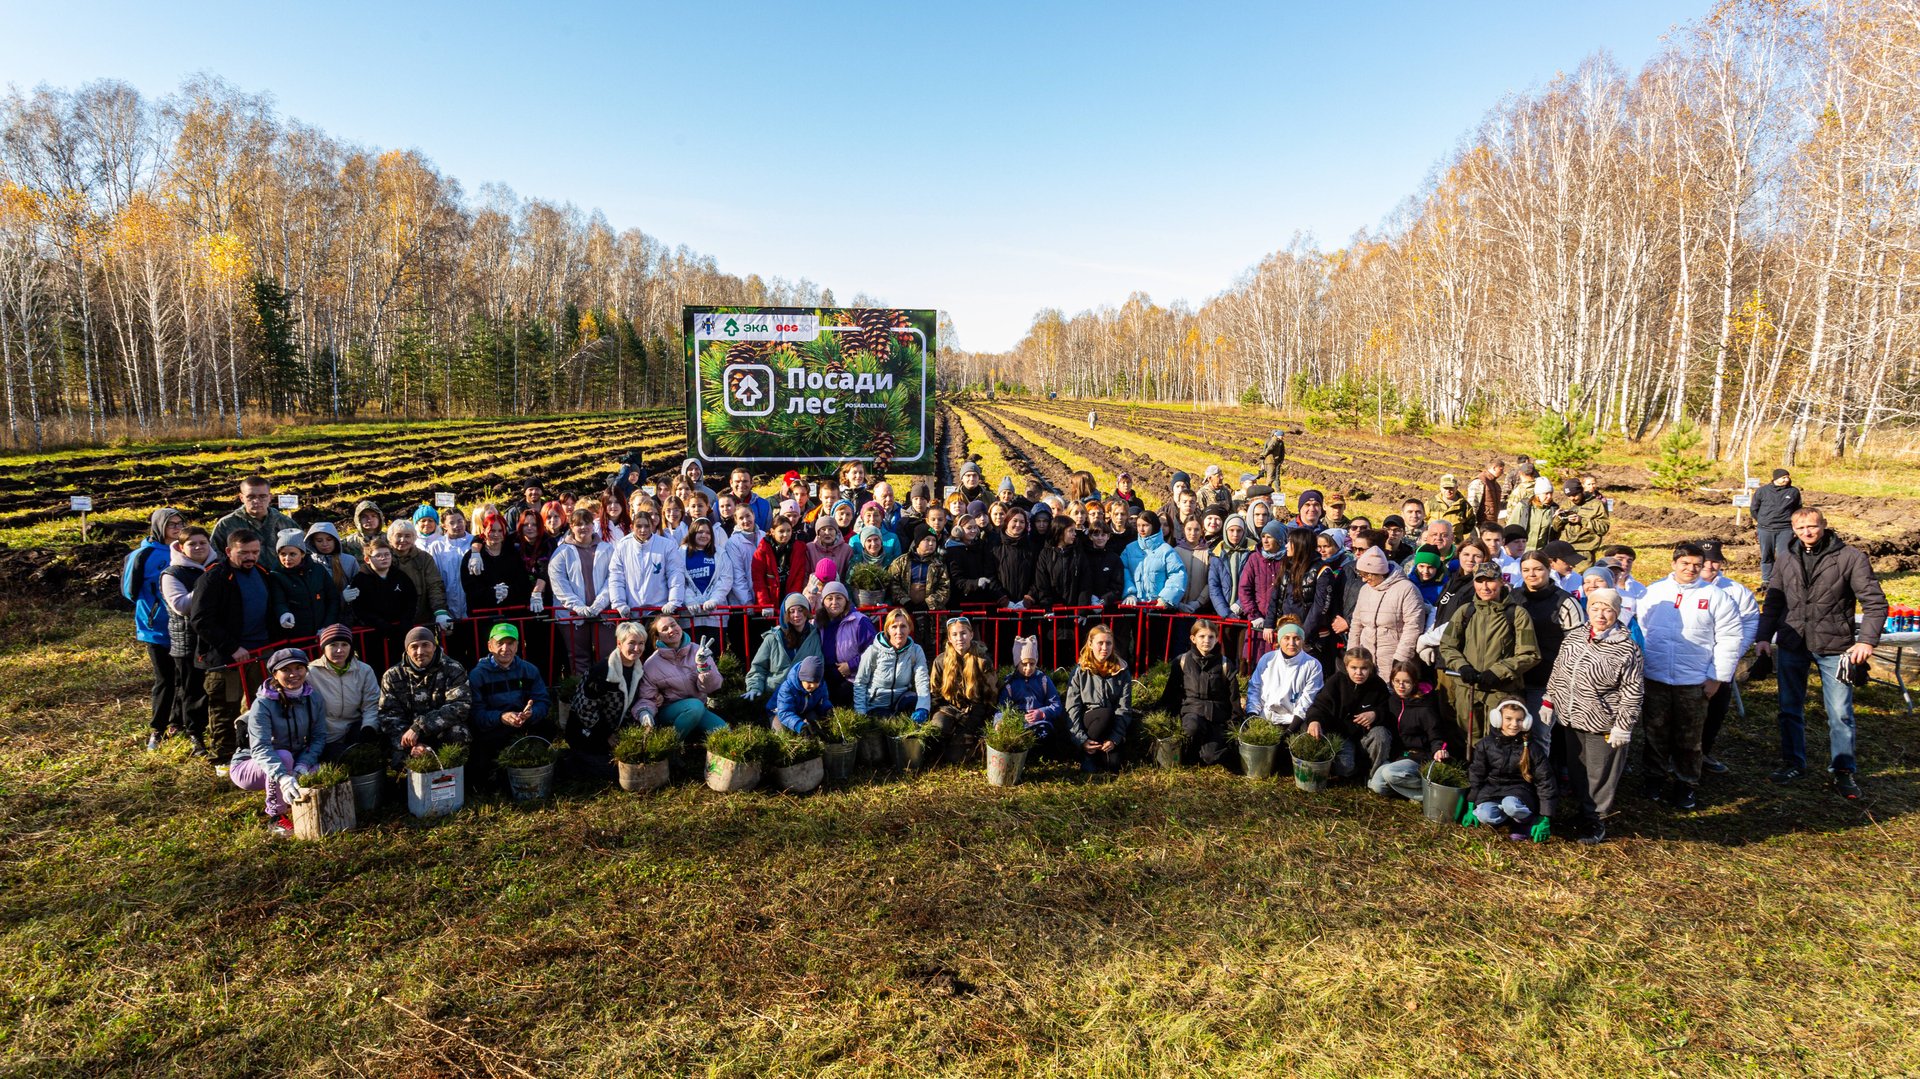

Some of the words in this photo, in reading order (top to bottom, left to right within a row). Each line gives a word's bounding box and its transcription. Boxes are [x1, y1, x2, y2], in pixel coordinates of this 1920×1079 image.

[743, 324, 769, 332] ЭКА
[787, 367, 893, 393] Посади
[785, 396, 837, 414] лес
